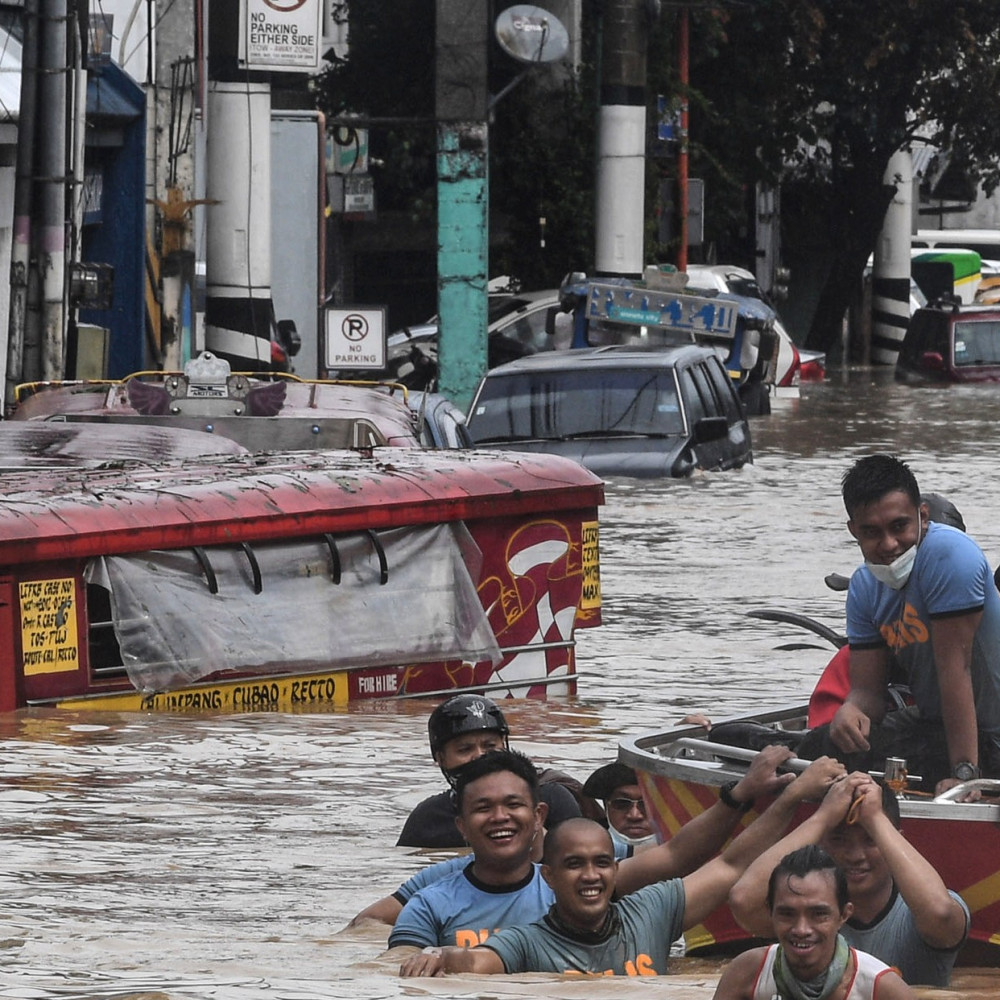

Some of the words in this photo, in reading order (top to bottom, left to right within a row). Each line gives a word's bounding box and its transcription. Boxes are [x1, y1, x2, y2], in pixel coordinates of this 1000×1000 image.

[250, 13, 265, 22] NO
[250, 23, 298, 35] PARKING
[250, 34, 288, 45] EITHER
[291, 35, 314, 46] SIDE
[335, 355, 376, 363] PARKING
[376, 674, 397, 692] HIRE
[233, 683, 279, 704] CUBAO
[291, 678, 335, 701] RECTO
